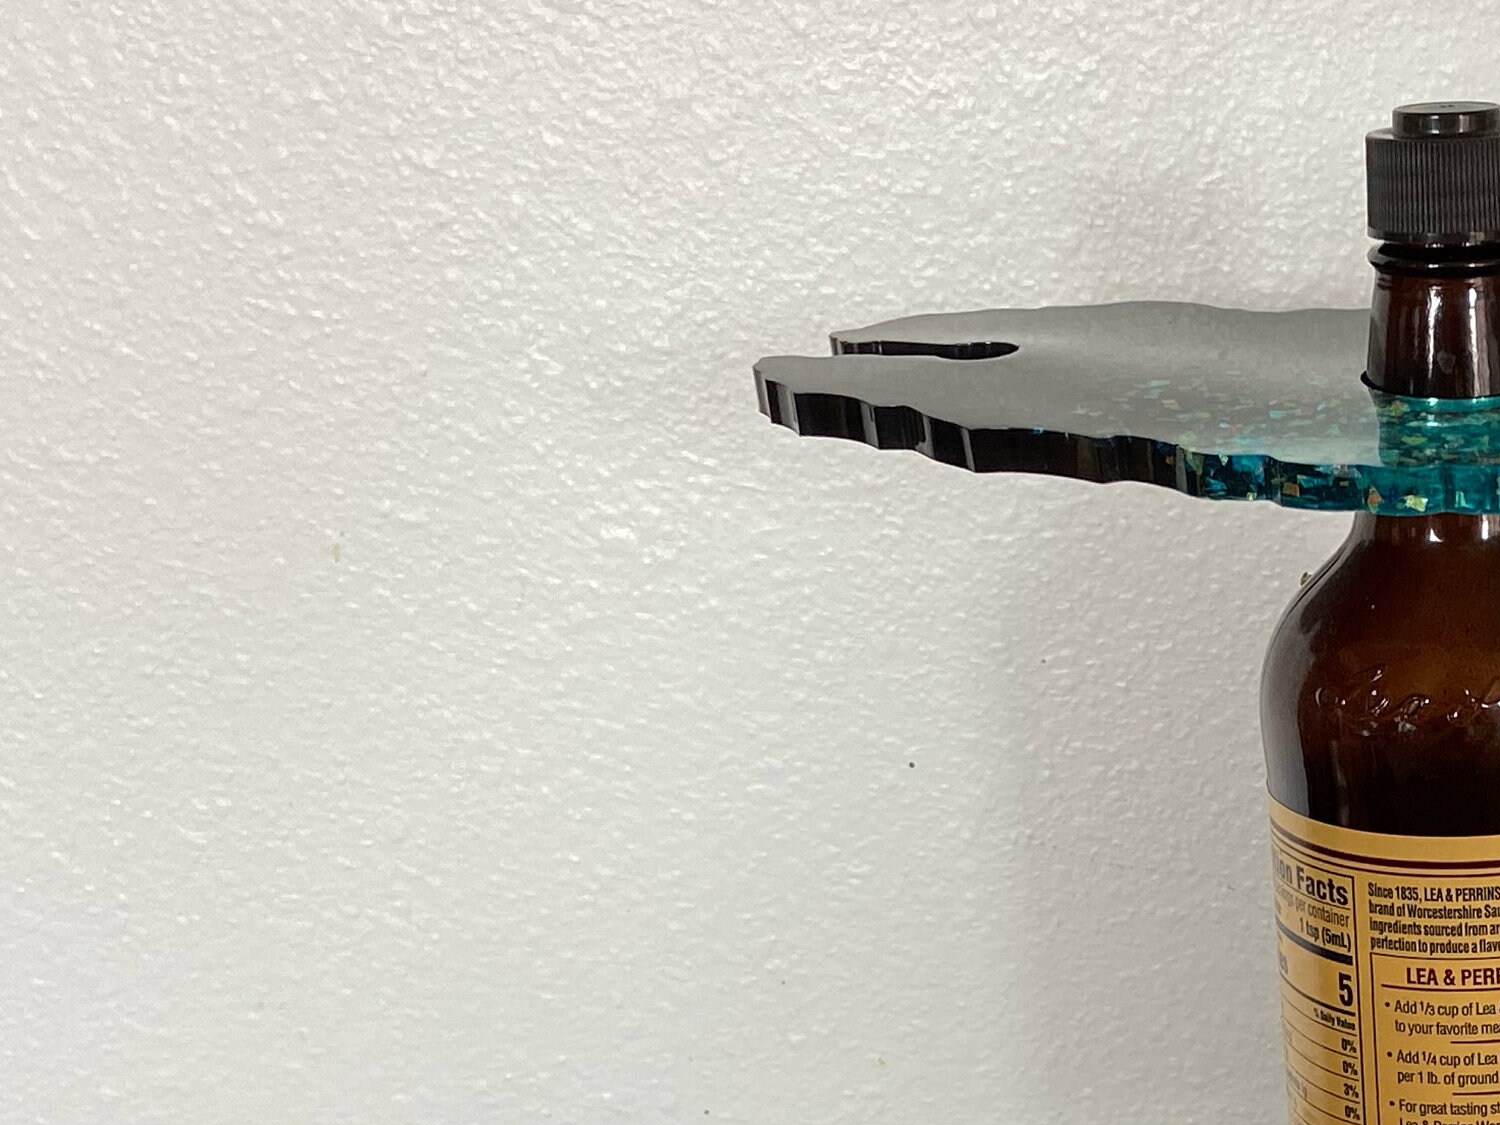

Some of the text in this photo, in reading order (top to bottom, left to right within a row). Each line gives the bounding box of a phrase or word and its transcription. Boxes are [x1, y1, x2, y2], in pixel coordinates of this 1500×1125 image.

[1296, 864, 1349, 906] Facts
[1368, 881, 1394, 899] Since
[1395, 885, 1423, 903] 1835,
[1424, 887, 1444, 902] LEA
[1445, 887, 1453, 903] &
[1308, 903, 1350, 928] container
[1369, 898, 1395, 917] brand
[1396, 904, 1406, 917] of
[1407, 903, 1483, 920] Worcestershire
[1423, 921, 1462, 936] sourced
[1464, 922, 1488, 936] from
[1322, 926, 1351, 953] (5mL)
[1370, 936, 1417, 951] perfection
[1418, 938, 1428, 953] to
[1429, 939, 1471, 956] produce
[1471, 944, 1478, 953] a
[1406, 967, 1439, 985] LEA
[1443, 969, 1456, 986] &
[1339, 971, 1354, 1007] 5
[1394, 999, 1417, 1014] Add
[1437, 1004, 1459, 1018] cup
[1461, 1002, 1474, 1016] of
[1475, 1002, 1496, 1016] Lea
[1394, 1019, 1406, 1033] to
[1407, 1022, 1433, 1036] your
[1436, 1021, 1479, 1036] favorite
[1341, 1037, 1357, 1053] 0%
[1342, 1060, 1358, 1076] 0%
[1397, 1049, 1419, 1065] Add
[1439, 1054, 1461, 1068] cup
[1463, 1052, 1475, 1066] of
[1477, 1052, 1498, 1066] Lea
[1397, 1071, 1415, 1084] per
[1418, 1071, 1424, 1084] 1
[1427, 1071, 1441, 1084] lb.
[1443, 1072, 1455, 1085] of
[1457, 1070, 1499, 1088] ground
[1344, 1105, 1361, 1121] 0%
[1398, 1098, 1417, 1113] For
[1420, 1101, 1447, 1117] great
[1450, 1102, 1488, 1118] tasting
